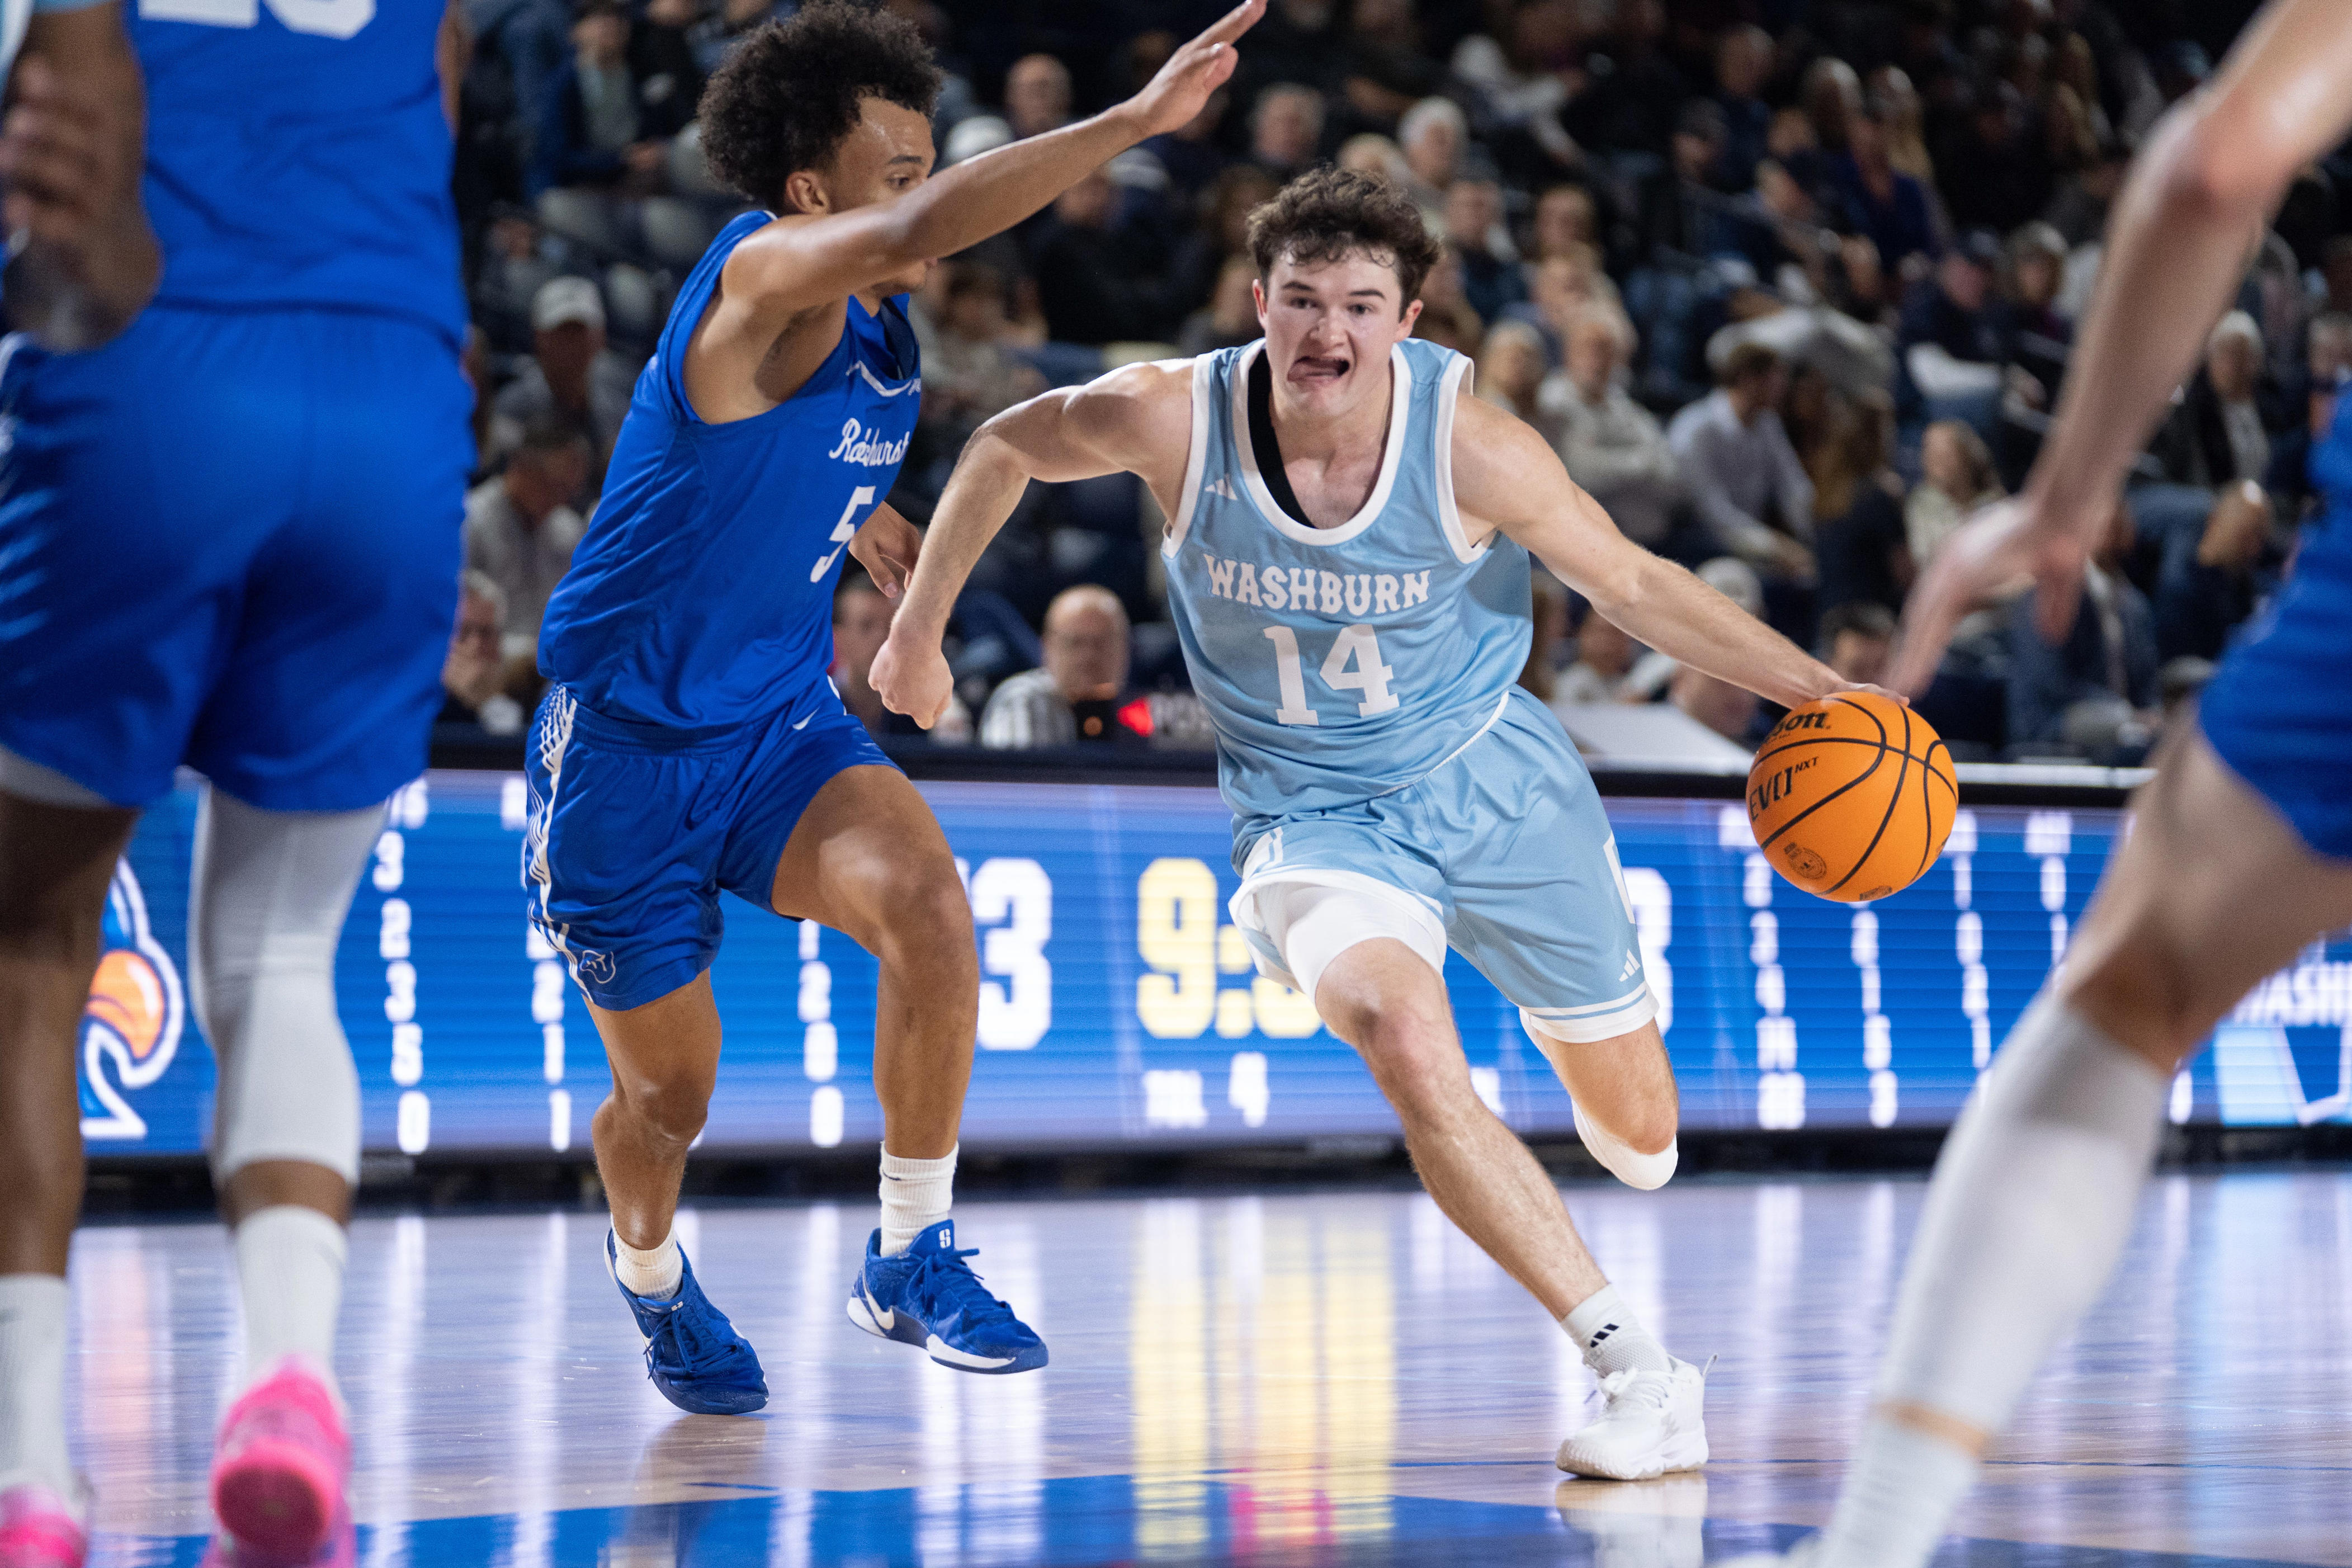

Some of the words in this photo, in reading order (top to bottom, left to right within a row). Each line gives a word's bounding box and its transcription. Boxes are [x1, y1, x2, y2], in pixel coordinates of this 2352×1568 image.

[810, 485, 876, 583] 5
[1203, 554, 1431, 616] WASHBURN
[1263, 624, 1399, 726] 14
[1765, 712, 1830, 744] son
[1794, 756, 1819, 774] NXT
[953, 857, 1053, 1051] 3
[2234, 961, 2352, 1028] ASH
